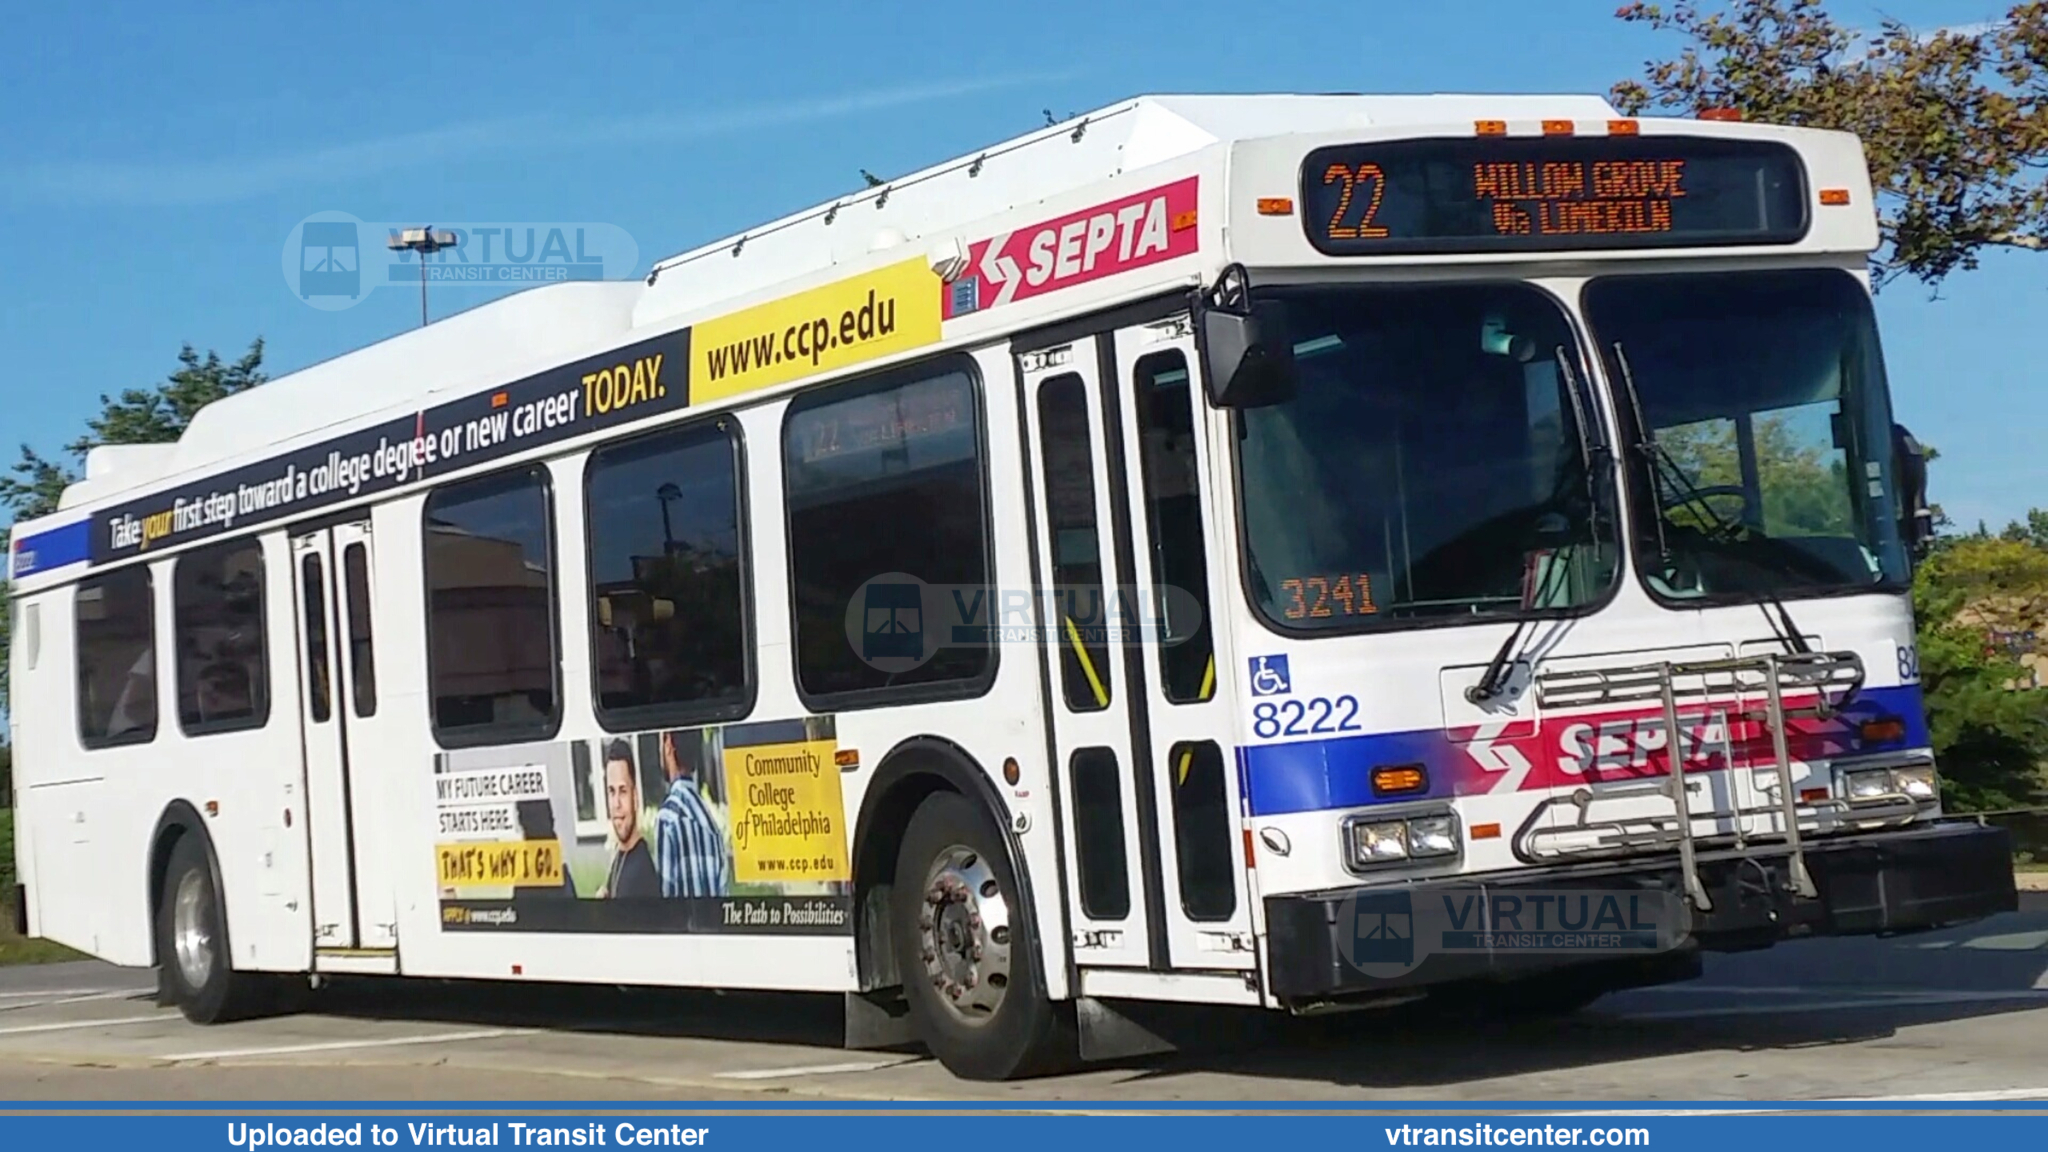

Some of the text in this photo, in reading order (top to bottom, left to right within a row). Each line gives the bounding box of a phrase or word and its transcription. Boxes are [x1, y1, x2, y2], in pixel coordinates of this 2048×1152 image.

[1473, 160, 1686, 200] WILLOW GROVE
[1323, 164, 1388, 238] 22
[1539, 200, 1672, 235] LIMEKILN
[1025, 195, 1169, 288] SEPTA
[707, 288, 895, 381] www.ccp.edu
[110, 354, 667, 551] Take your first step toward a college degree or new career TODAY.
[1281, 573, 1379, 620] 3241
[1252, 694, 1362, 739] 8222
[745, 749, 821, 779] Community
[436, 772, 545, 800] MY FUTURE CAREER
[748, 782, 796, 812] College
[439, 808, 513, 834] STARTS HERE.
[735, 808, 832, 850] of Philadelphia
[442, 847, 559, 881] THAT'S WHY I GO.
[757, 854, 835, 874] www.ccp.edu
[722, 901, 845, 925] The Path to Possibilities
